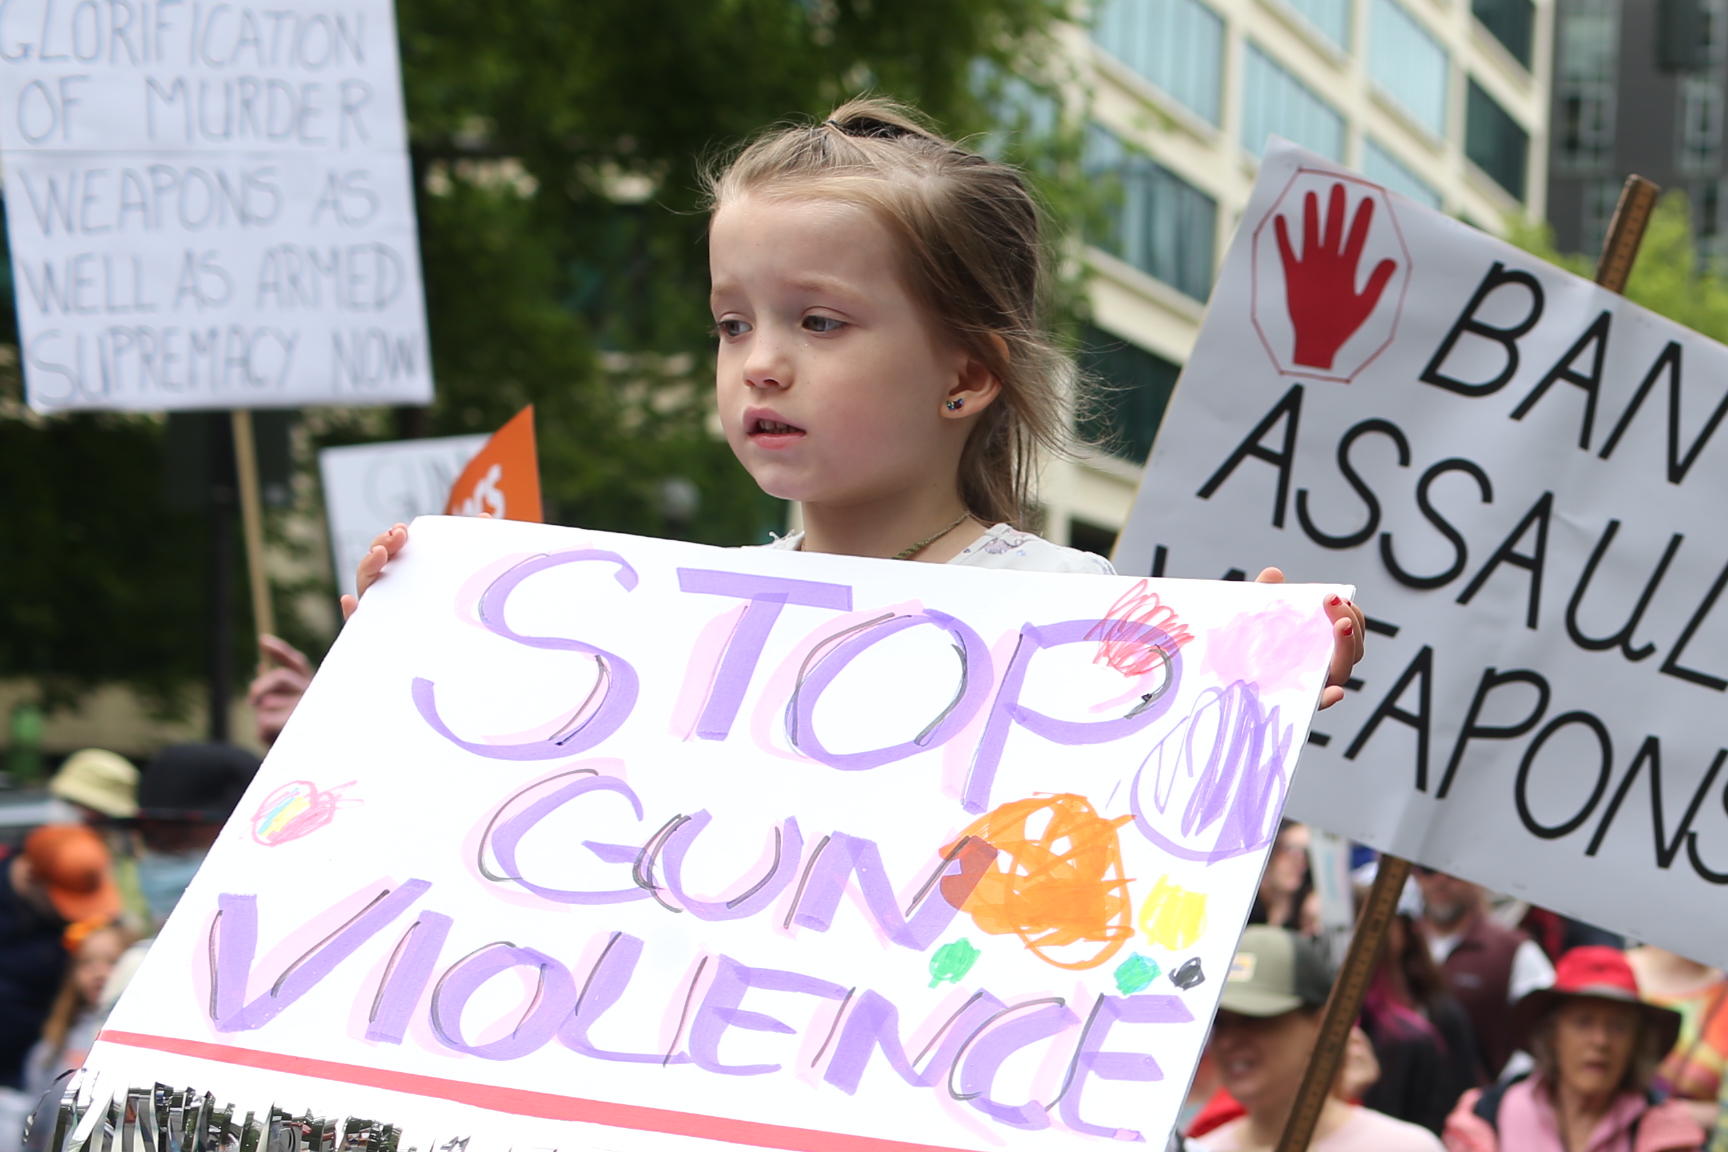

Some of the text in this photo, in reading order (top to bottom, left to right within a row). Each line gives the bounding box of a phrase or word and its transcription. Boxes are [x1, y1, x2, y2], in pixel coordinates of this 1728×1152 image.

[16, 74, 374, 150] OF MURDER
[18, 163, 382, 237] WEAPONS AS
[20, 242, 404, 317] WELL AS ARMED
[28, 324, 422, 405] SUPREMACY NOW
[412, 546, 1182, 812] STOP
[480, 762, 998, 950] GUN
[204, 876, 1192, 1142] VIOLENCE
